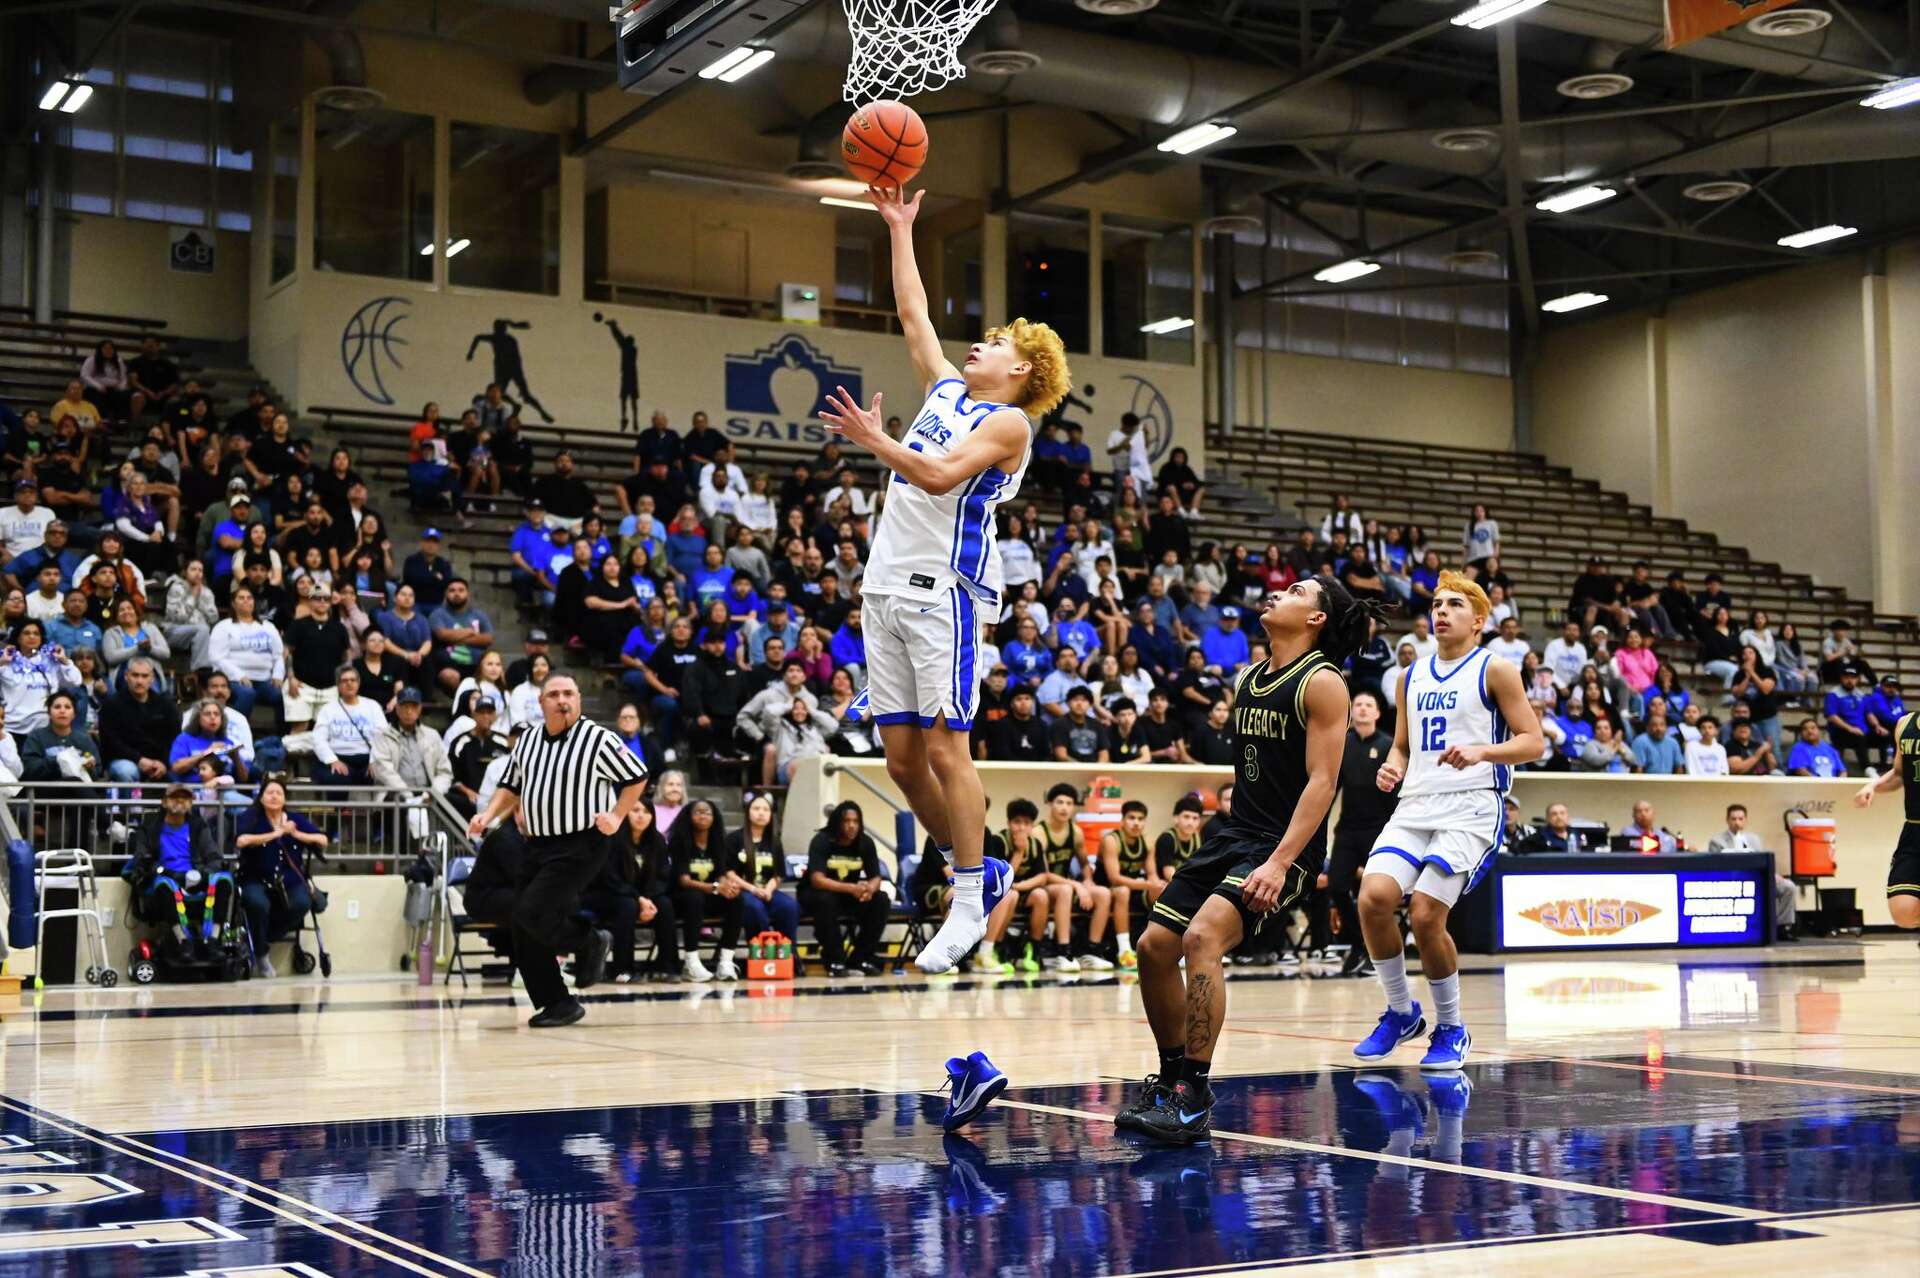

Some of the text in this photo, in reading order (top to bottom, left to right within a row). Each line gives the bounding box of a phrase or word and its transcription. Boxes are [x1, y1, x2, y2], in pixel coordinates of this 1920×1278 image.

[725, 416, 857, 445] SAIS
[1417, 691, 1458, 711] VOKS
[1241, 707, 1289, 740] LEGACY
[1421, 716, 1447, 751] 12
[1244, 744, 1260, 782] 3
[1540, 903, 1641, 930] SAISD
